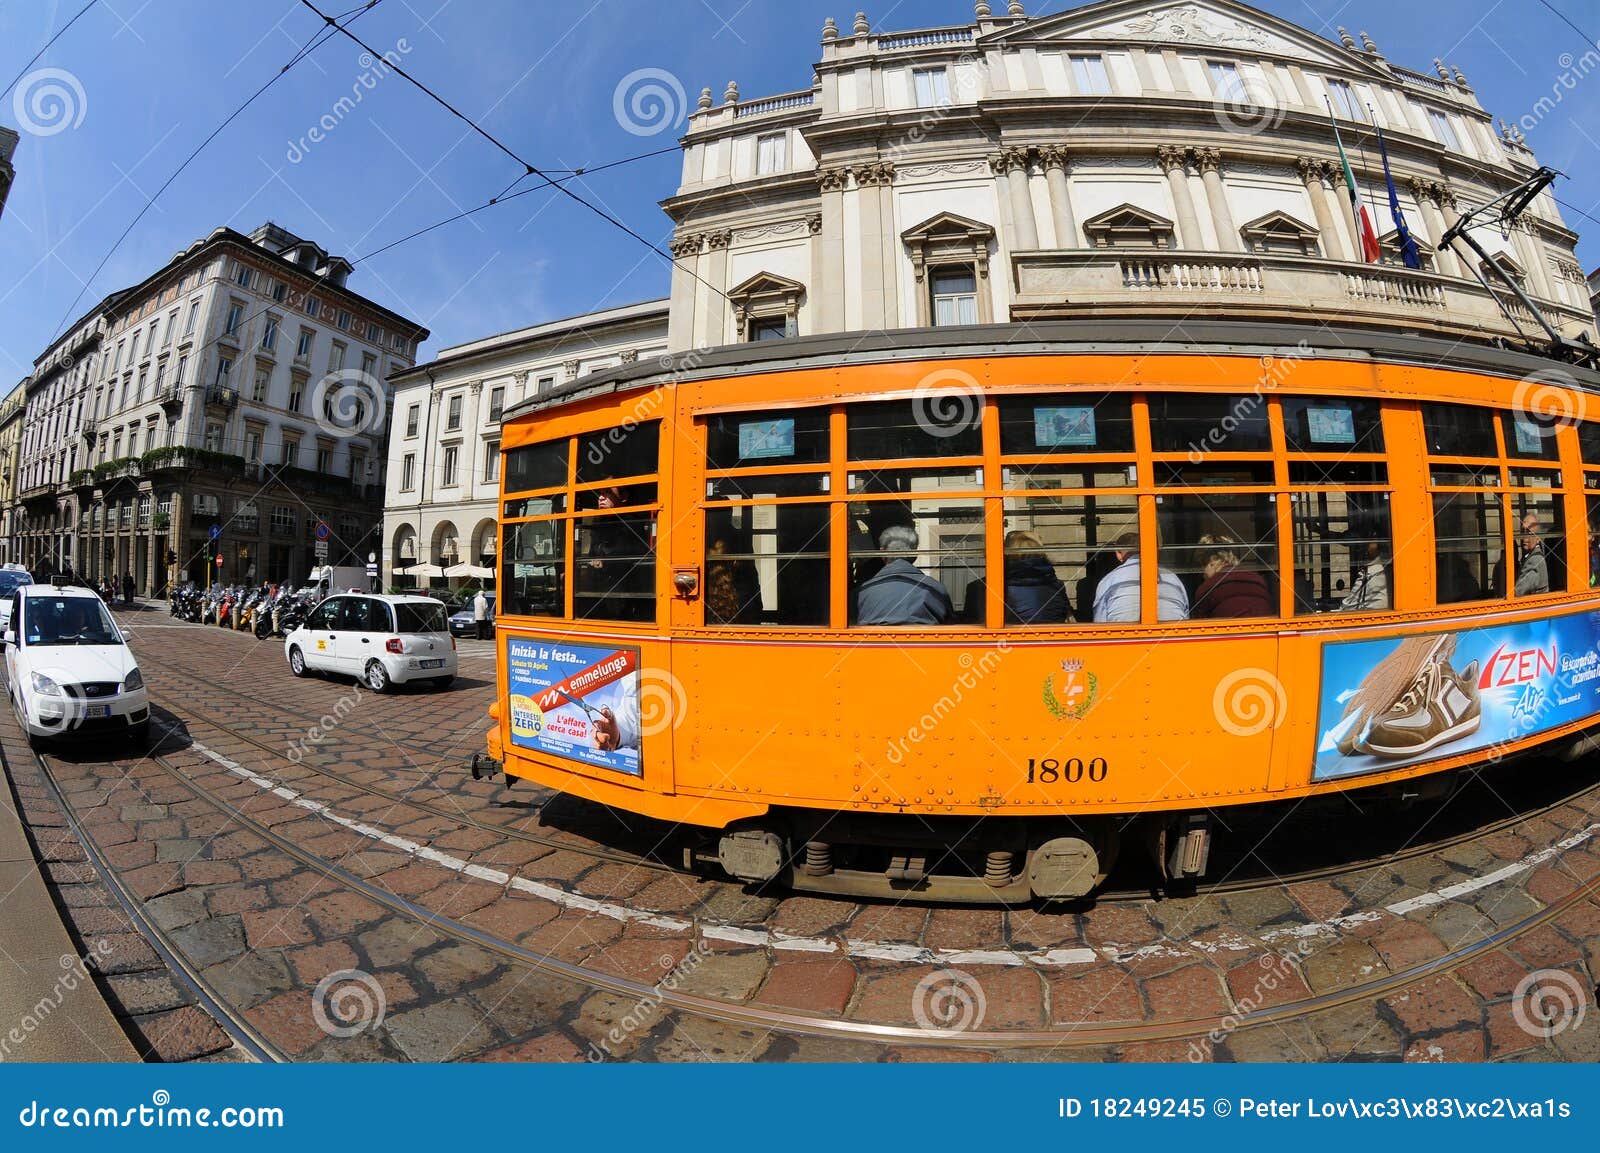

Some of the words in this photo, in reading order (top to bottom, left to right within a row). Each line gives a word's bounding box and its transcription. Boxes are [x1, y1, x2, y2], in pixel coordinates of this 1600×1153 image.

[511, 645, 537, 659] Inizia
[540, 648, 549, 660] la
[551, 649, 586, 664] festa...
[570, 656, 627, 690] emmelunga
[1511, 682, 1544, 719] Air
[515, 717, 541, 732] ZERO
[546, 723, 566, 735] cerca
[567, 728, 588, 738] casa!
[556, 714, 587, 728] L'affare
[1026, 757, 1108, 783] 1800
